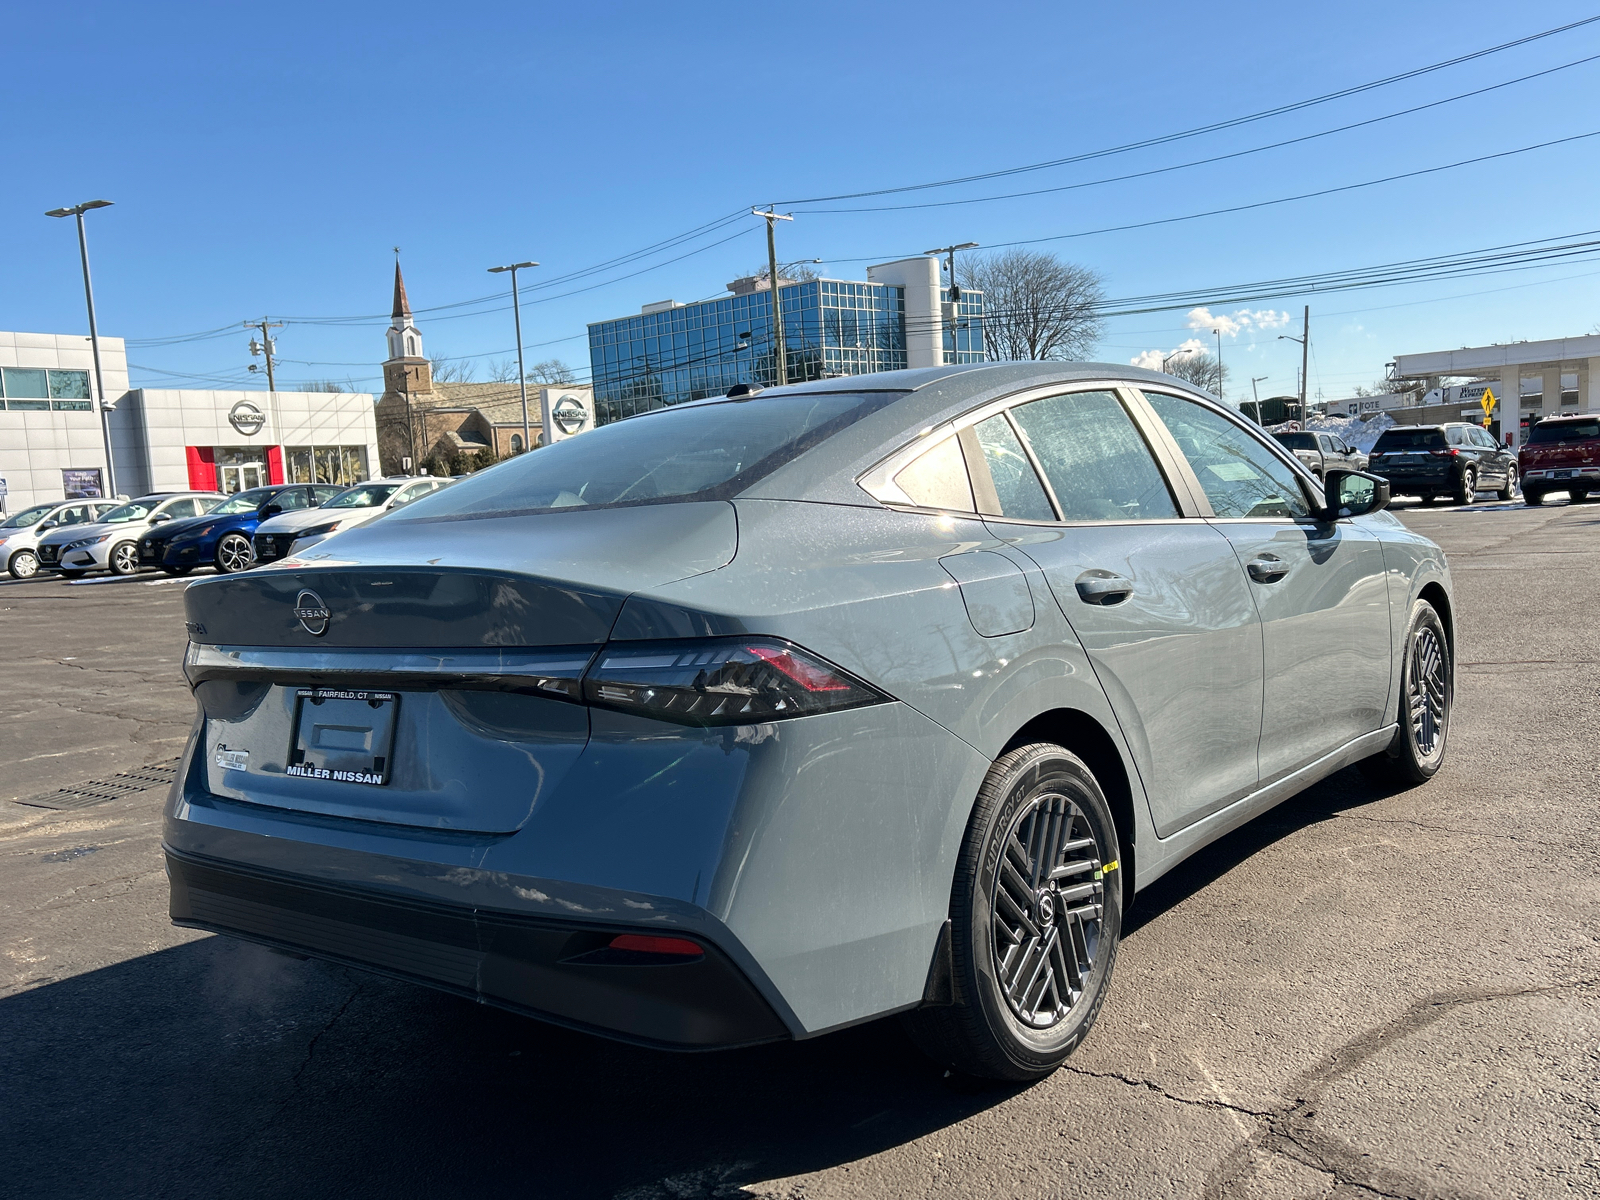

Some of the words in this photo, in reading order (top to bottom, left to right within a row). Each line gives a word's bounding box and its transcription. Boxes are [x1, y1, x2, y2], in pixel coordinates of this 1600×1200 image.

[1361, 401, 1380, 410] TOTE
[557, 410, 587, 418] NISSAN
[318, 690, 356, 700] FAIRFIELD,
[357, 691, 368, 699] CT
[287, 766, 330, 779] MILLER
[333, 770, 382, 784] NISSAN
[986, 796, 1015, 875] KINERGY
[1016, 785, 1025, 803] GT
